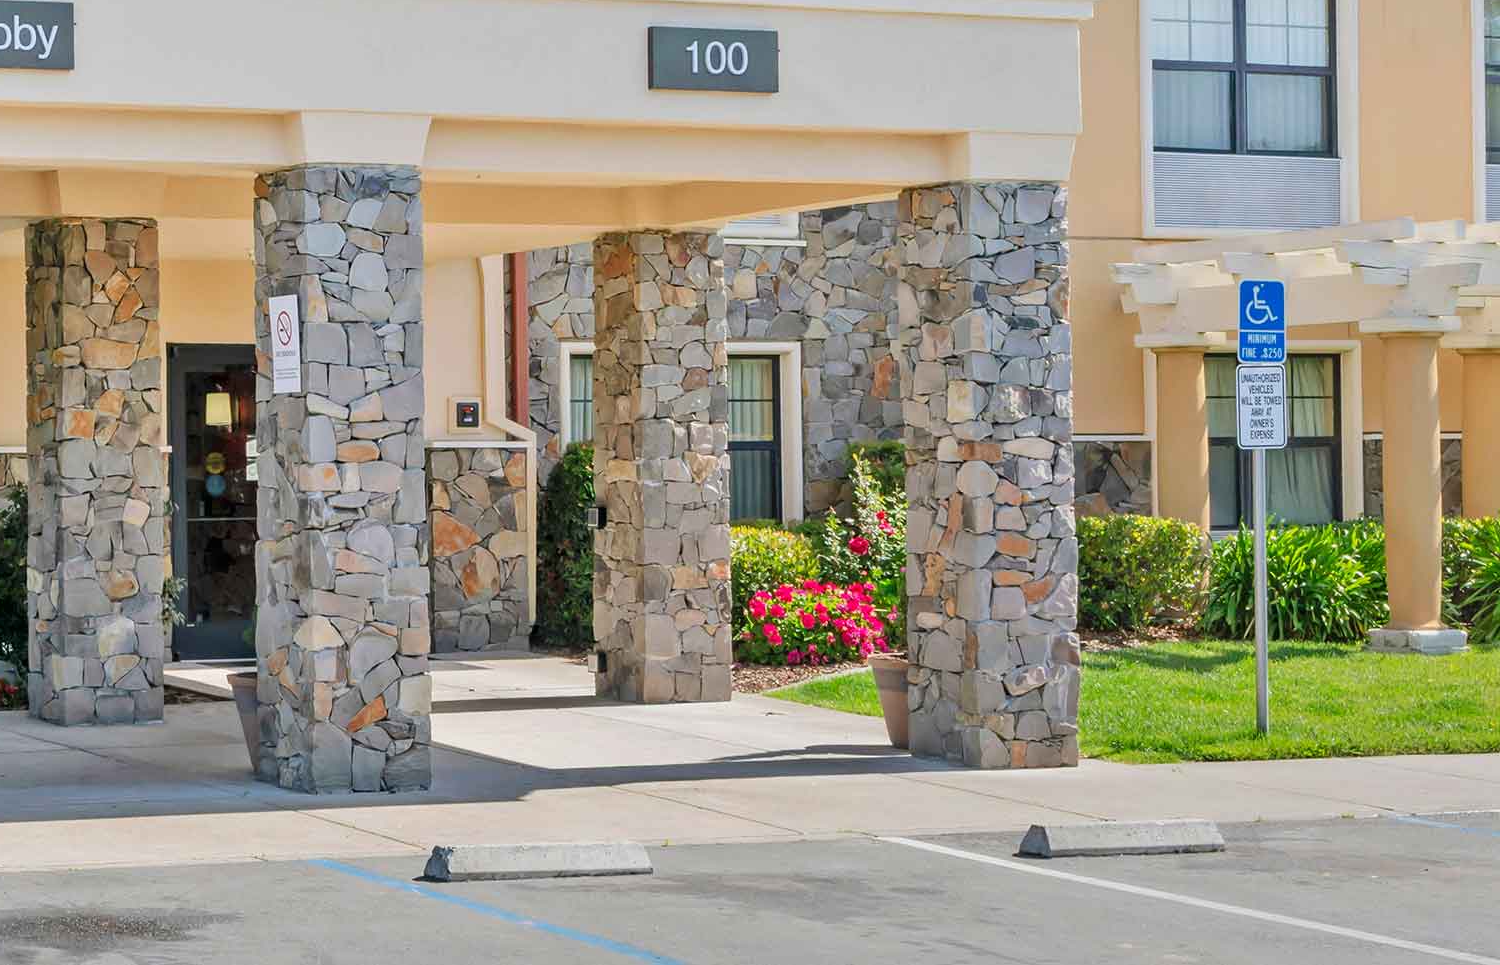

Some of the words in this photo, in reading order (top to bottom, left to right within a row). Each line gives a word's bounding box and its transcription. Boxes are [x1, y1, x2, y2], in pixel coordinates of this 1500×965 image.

[685, 40, 749, 76] 100
[1247, 333, 1277, 345] MINIMUM
[1241, 373, 1281, 383] UNAUTHORIZED
[1248, 385, 1275, 395] VEHICLES
[1254, 396, 1263, 406] BE
[1250, 429, 1275, 440] EXPENSE
